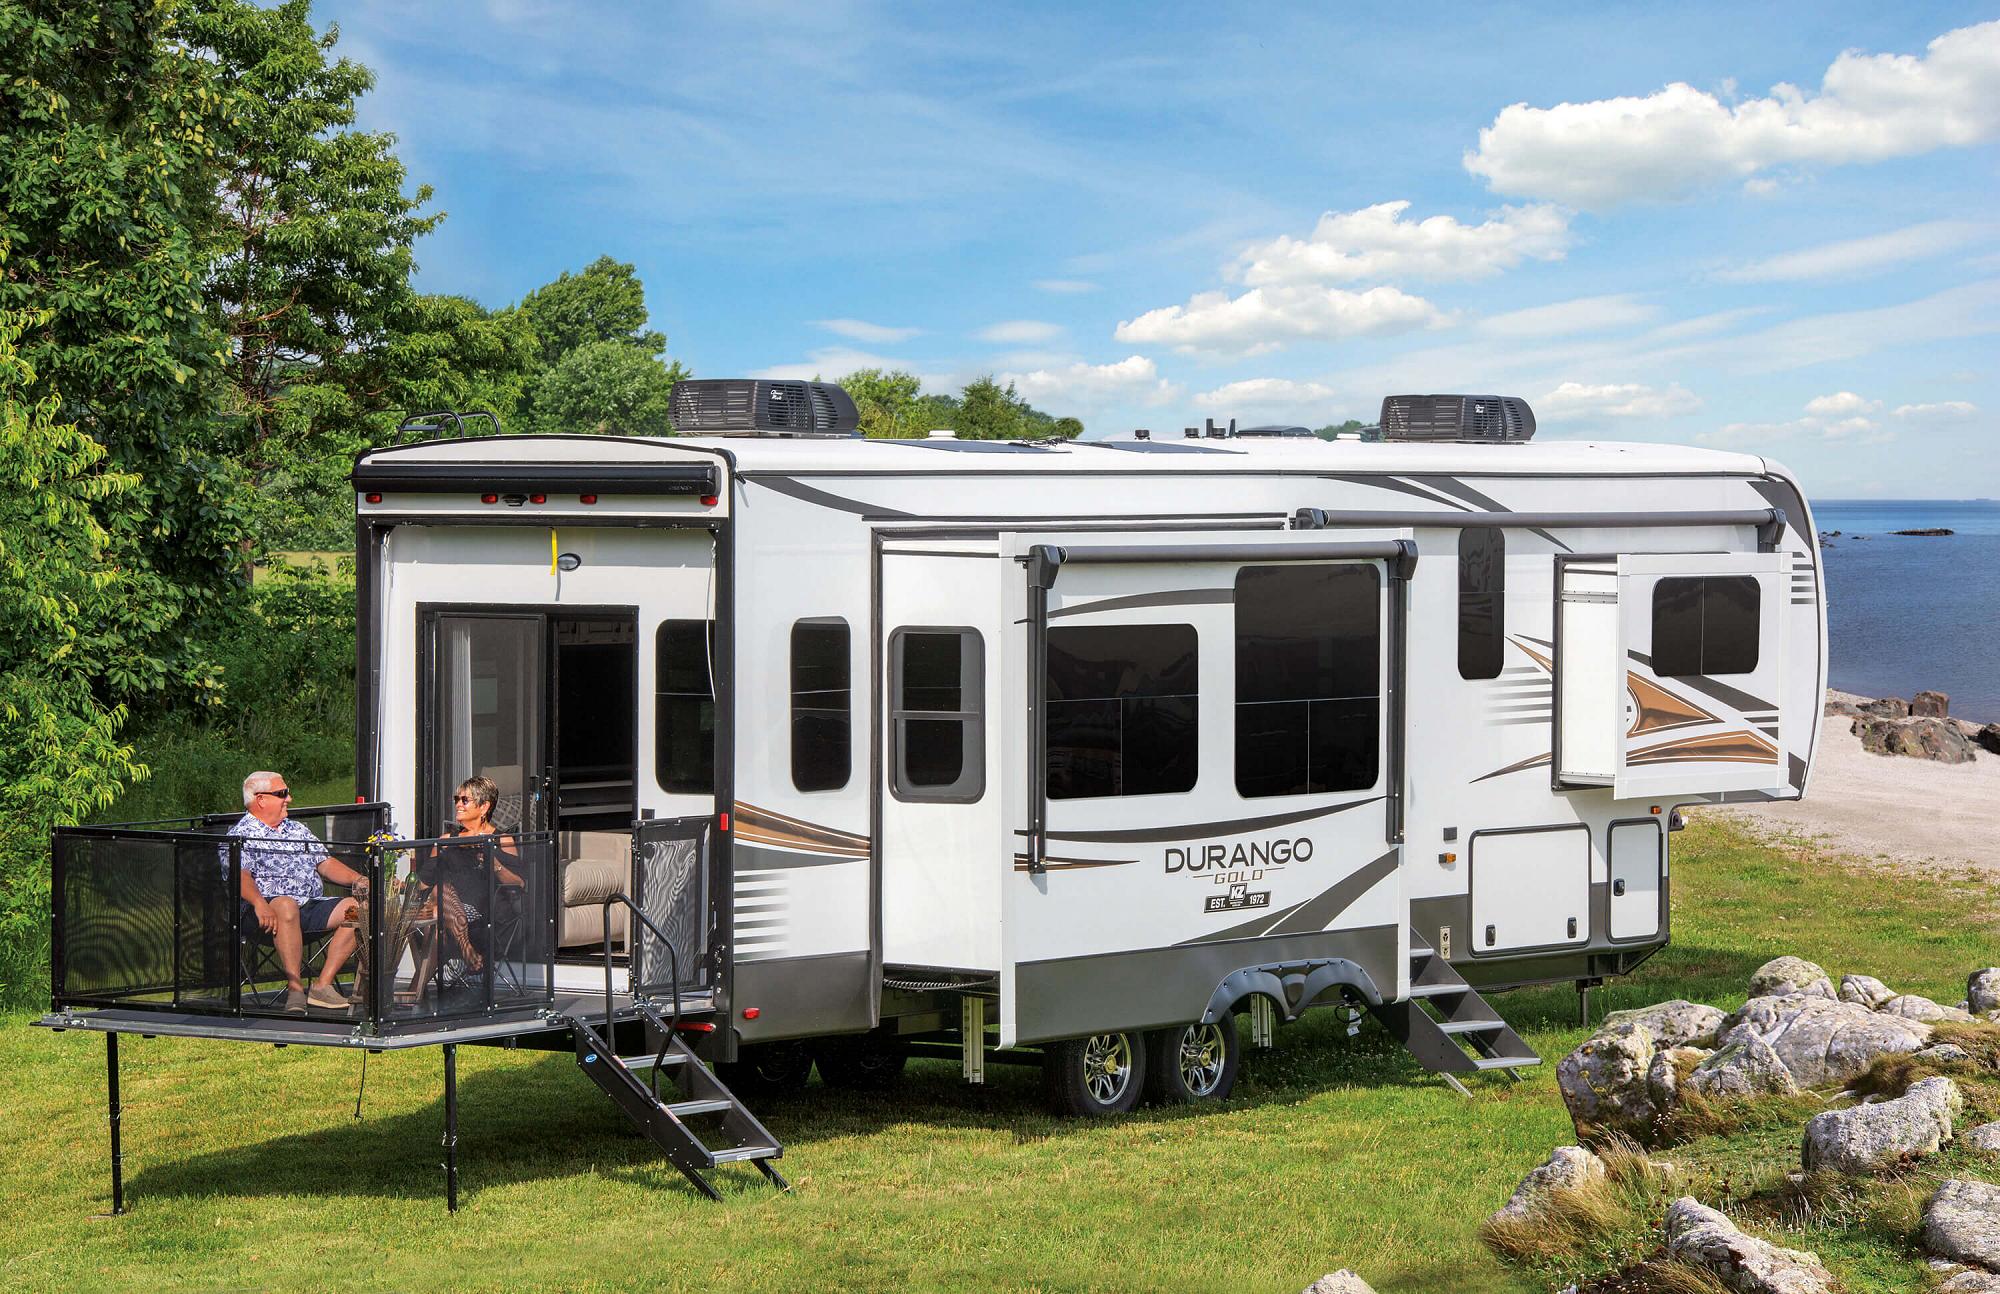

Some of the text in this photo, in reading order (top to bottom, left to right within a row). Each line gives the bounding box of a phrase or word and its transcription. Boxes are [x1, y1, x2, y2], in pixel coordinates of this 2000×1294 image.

[1165, 837, 1313, 873] DURANGO
[1214, 869, 1263, 884] GOLD
[1230, 885, 1245, 900] KZ
[1210, 897, 1226, 909] EST.
[1249, 893, 1265, 905] 1972
